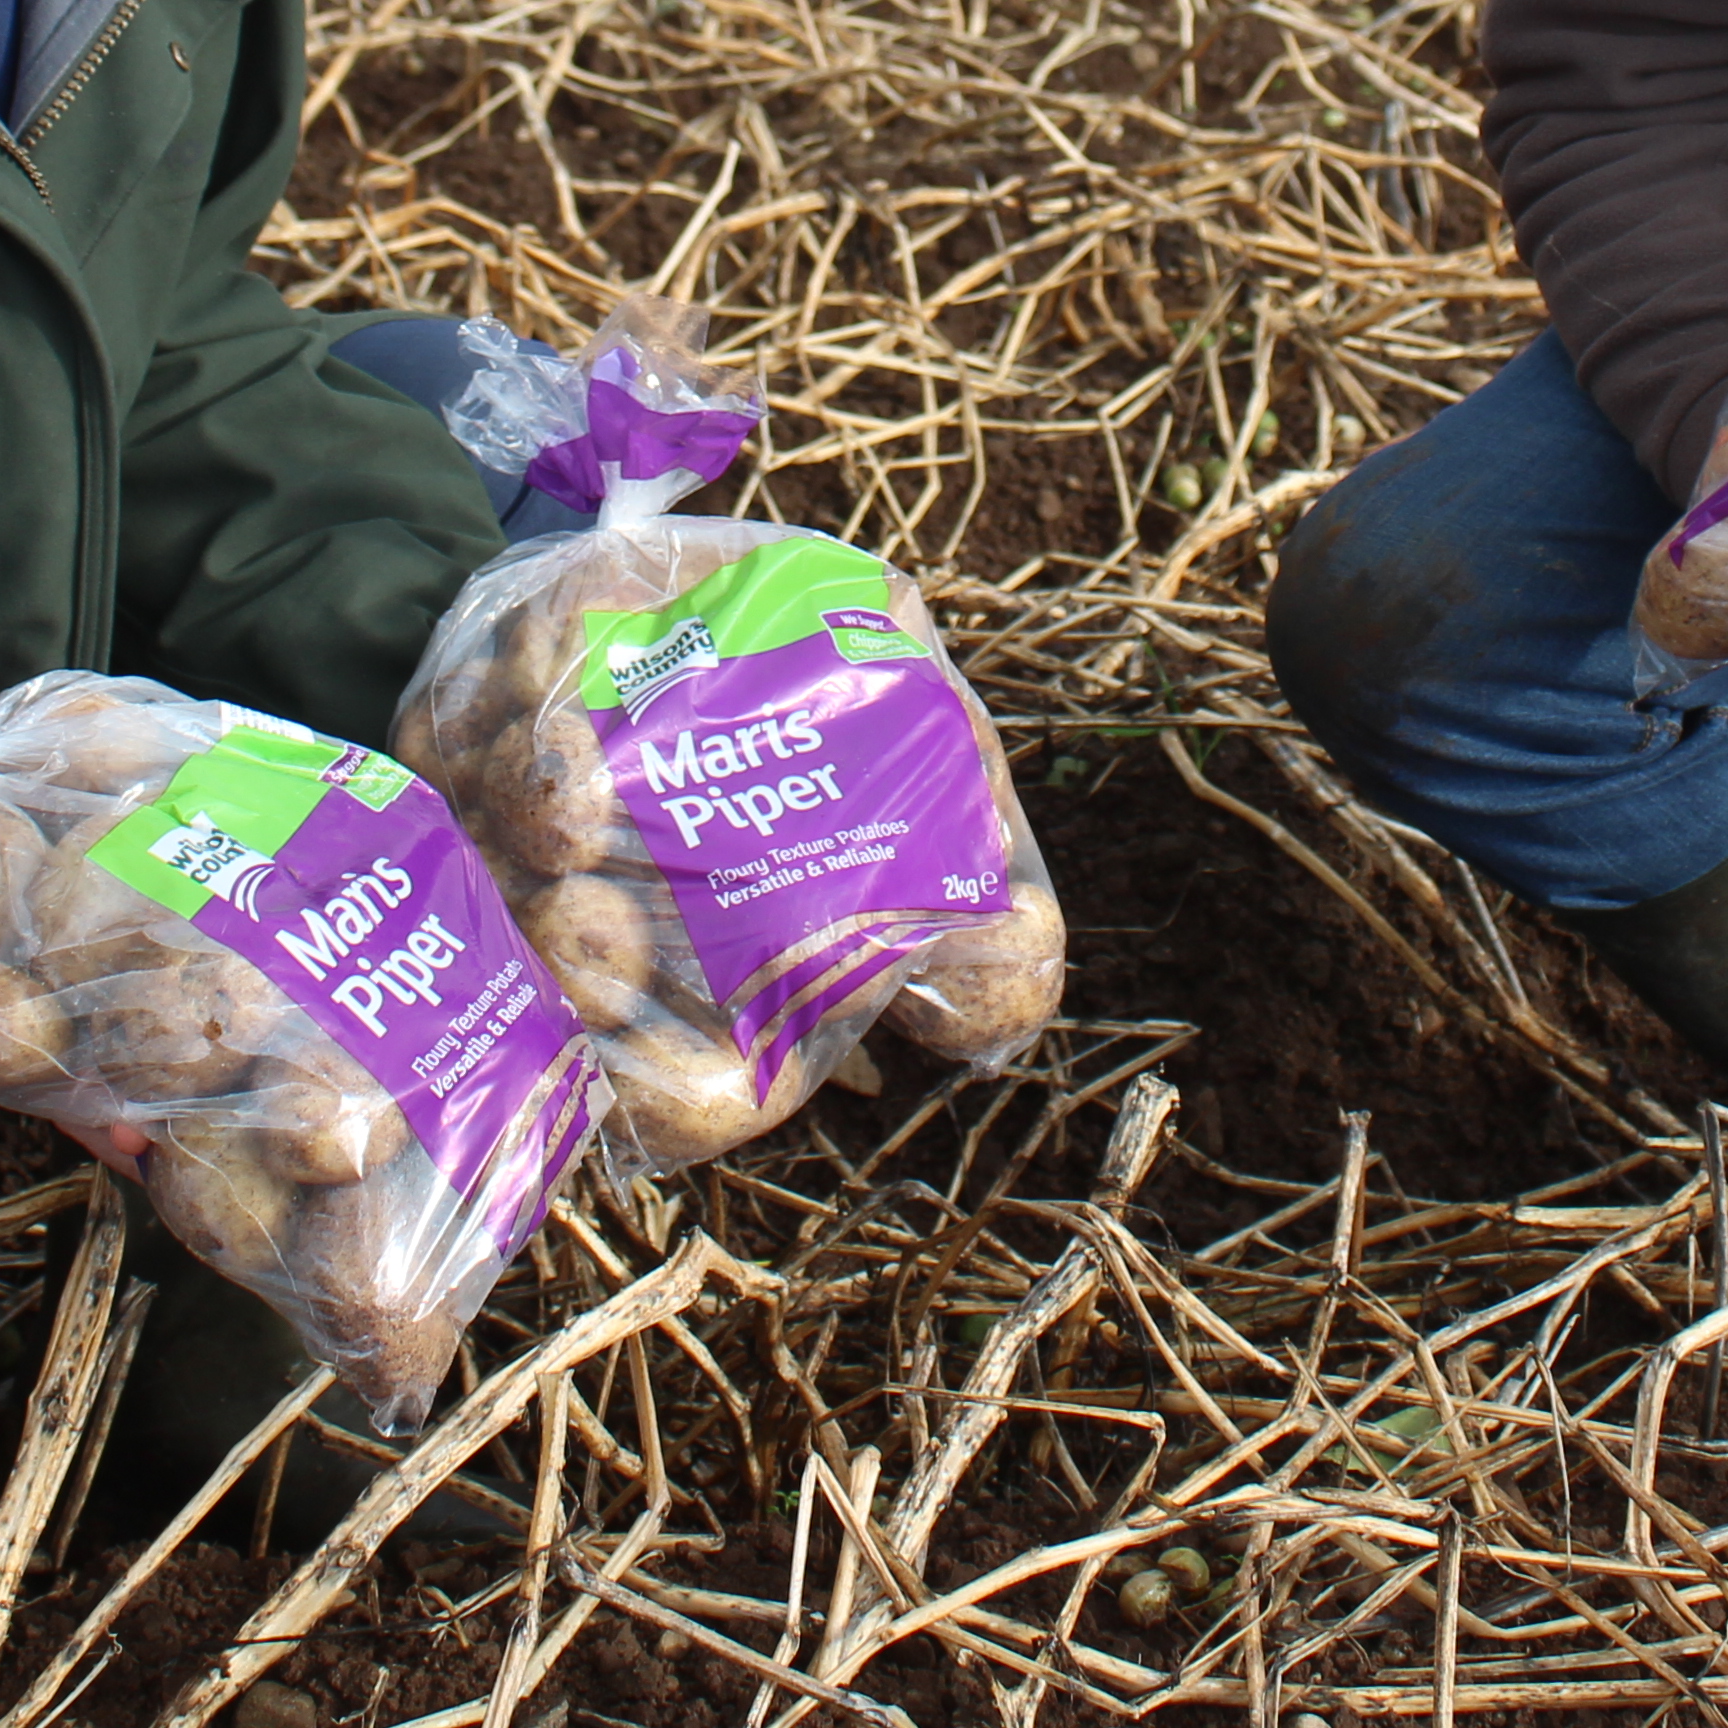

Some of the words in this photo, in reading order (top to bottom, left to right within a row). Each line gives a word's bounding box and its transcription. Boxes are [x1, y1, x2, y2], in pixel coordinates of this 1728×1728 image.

[617, 633, 716, 696] country
[639, 702, 823, 794] Maris
[660, 763, 844, 849] Piper
[706, 857, 770, 890] Floury
[767, 837, 837, 865] Texture
[834, 819, 910, 845] Potatoes
[715, 867, 806, 910] Versatile
[805, 860, 825, 878] &
[823, 843, 897, 872] Reliable
[942, 874, 981, 904] 2kg
[274, 856, 414, 982] Maris
[330, 912, 467, 1039] Piper
[411, 1032, 463, 1080] Floury
[448, 989, 498, 1036] Texture
[429, 1033, 496, 1100] Versatile
[486, 1019, 508, 1037] &
